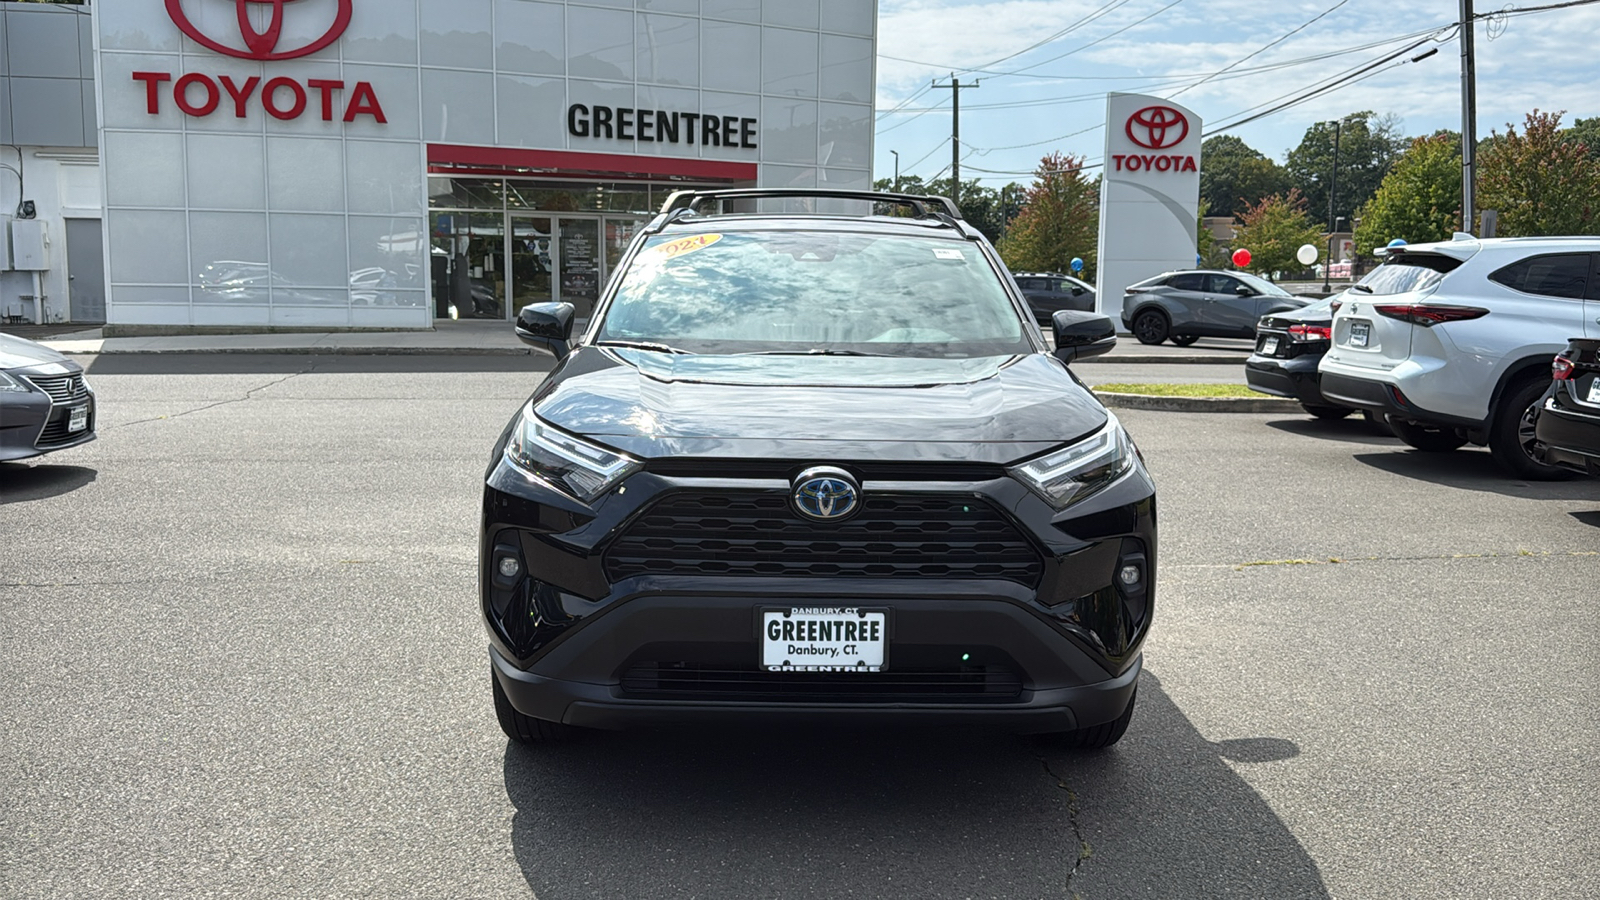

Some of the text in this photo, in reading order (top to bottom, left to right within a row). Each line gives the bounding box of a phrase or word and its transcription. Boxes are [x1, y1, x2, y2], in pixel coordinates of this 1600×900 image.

[132, 71, 388, 124] TOYOTA
[568, 103, 757, 149] GREENTREE
[1112, 154, 1197, 172] TOYOTA
[791, 607, 842, 616] DANBURY,
[767, 619, 880, 642] GREENTREE
[787, 644, 858, 658] Danbury, CT.
[767, 665, 881, 673] GREENTREE
